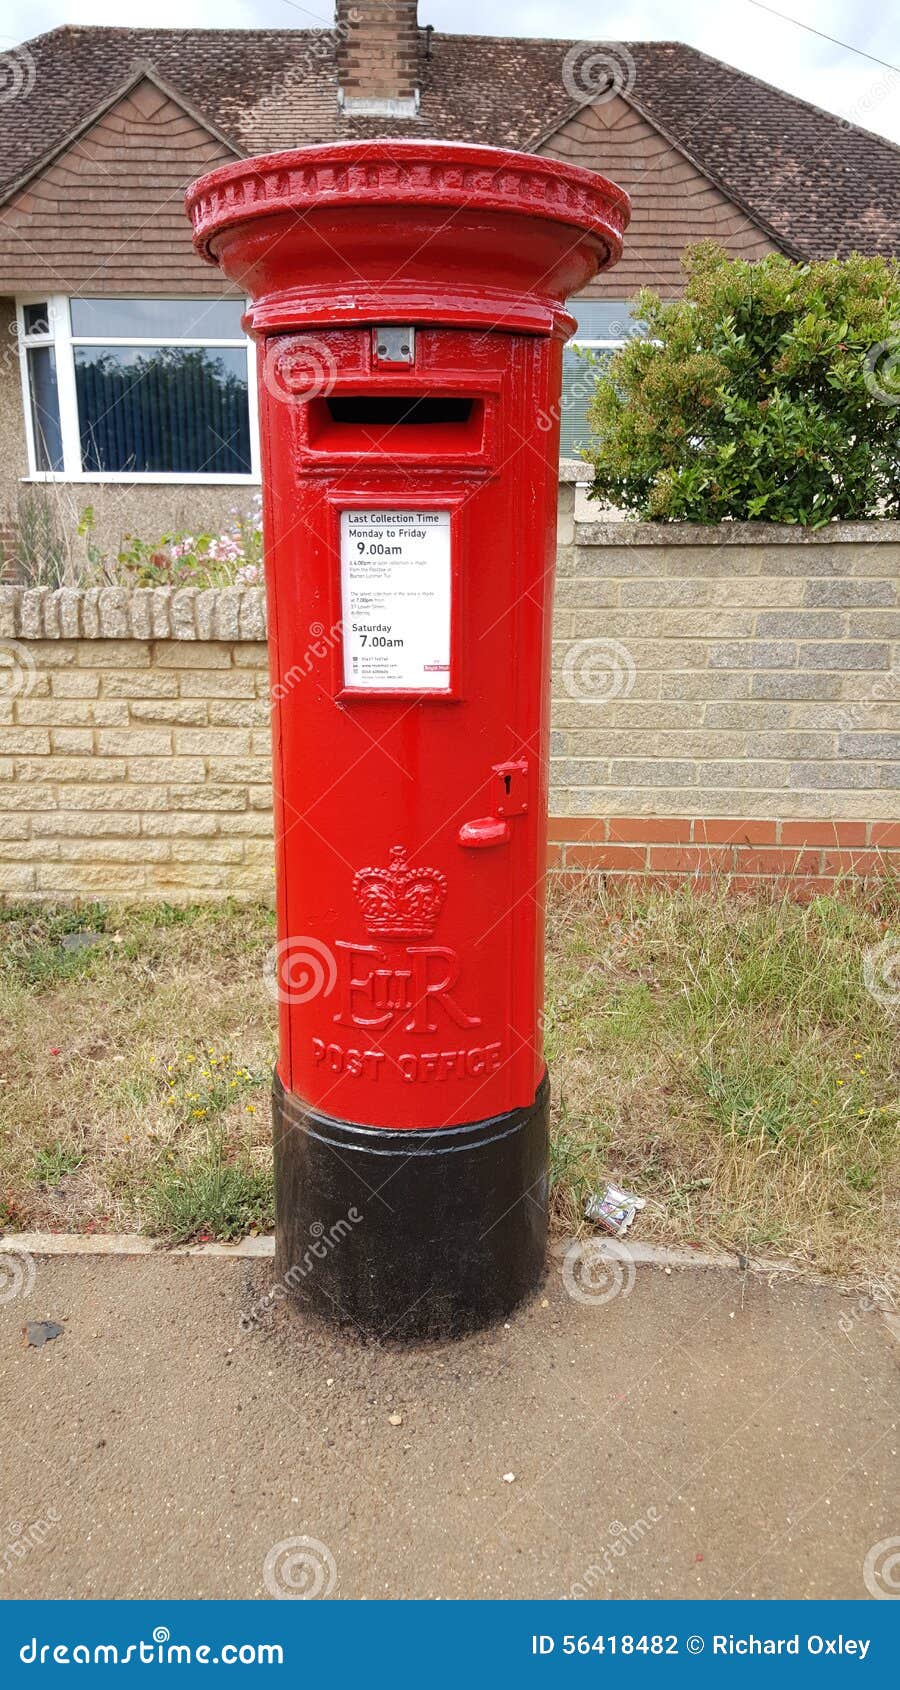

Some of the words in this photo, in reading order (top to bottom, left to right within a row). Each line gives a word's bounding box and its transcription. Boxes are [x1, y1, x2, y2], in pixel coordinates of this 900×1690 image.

[348, 514, 368, 523] Last
[370, 514, 414, 523] Collection
[416, 513, 439, 523] Time
[349, 529, 384, 539] Monday
[386, 530, 396, 538] to
[399, 529, 427, 539] Friday
[357, 541, 402, 555] 9.00am
[352, 623, 392, 633] Saturday
[359, 635, 404, 648] 7.00am
[311, 1036, 385, 1082] POST
[399, 1041, 502, 1083] OFFICE
